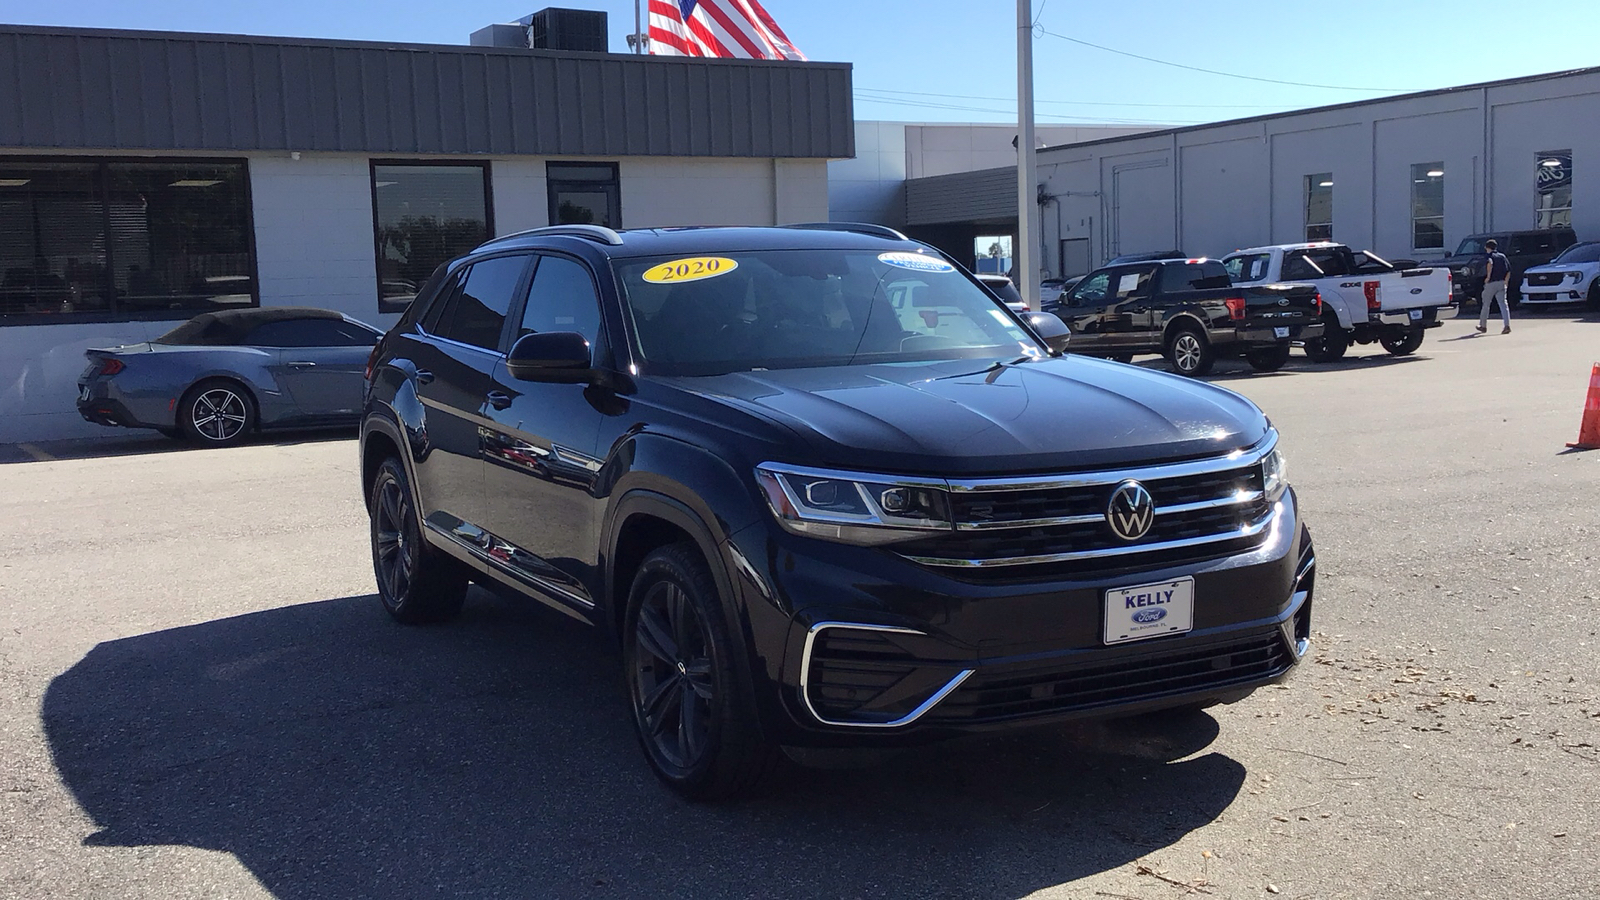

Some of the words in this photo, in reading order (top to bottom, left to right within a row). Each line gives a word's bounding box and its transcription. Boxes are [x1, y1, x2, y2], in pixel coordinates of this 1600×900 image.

[661, 259, 720, 280] 2020
[1125, 590, 1174, 609] KELLY
[1138, 611, 1161, 622] Ford
